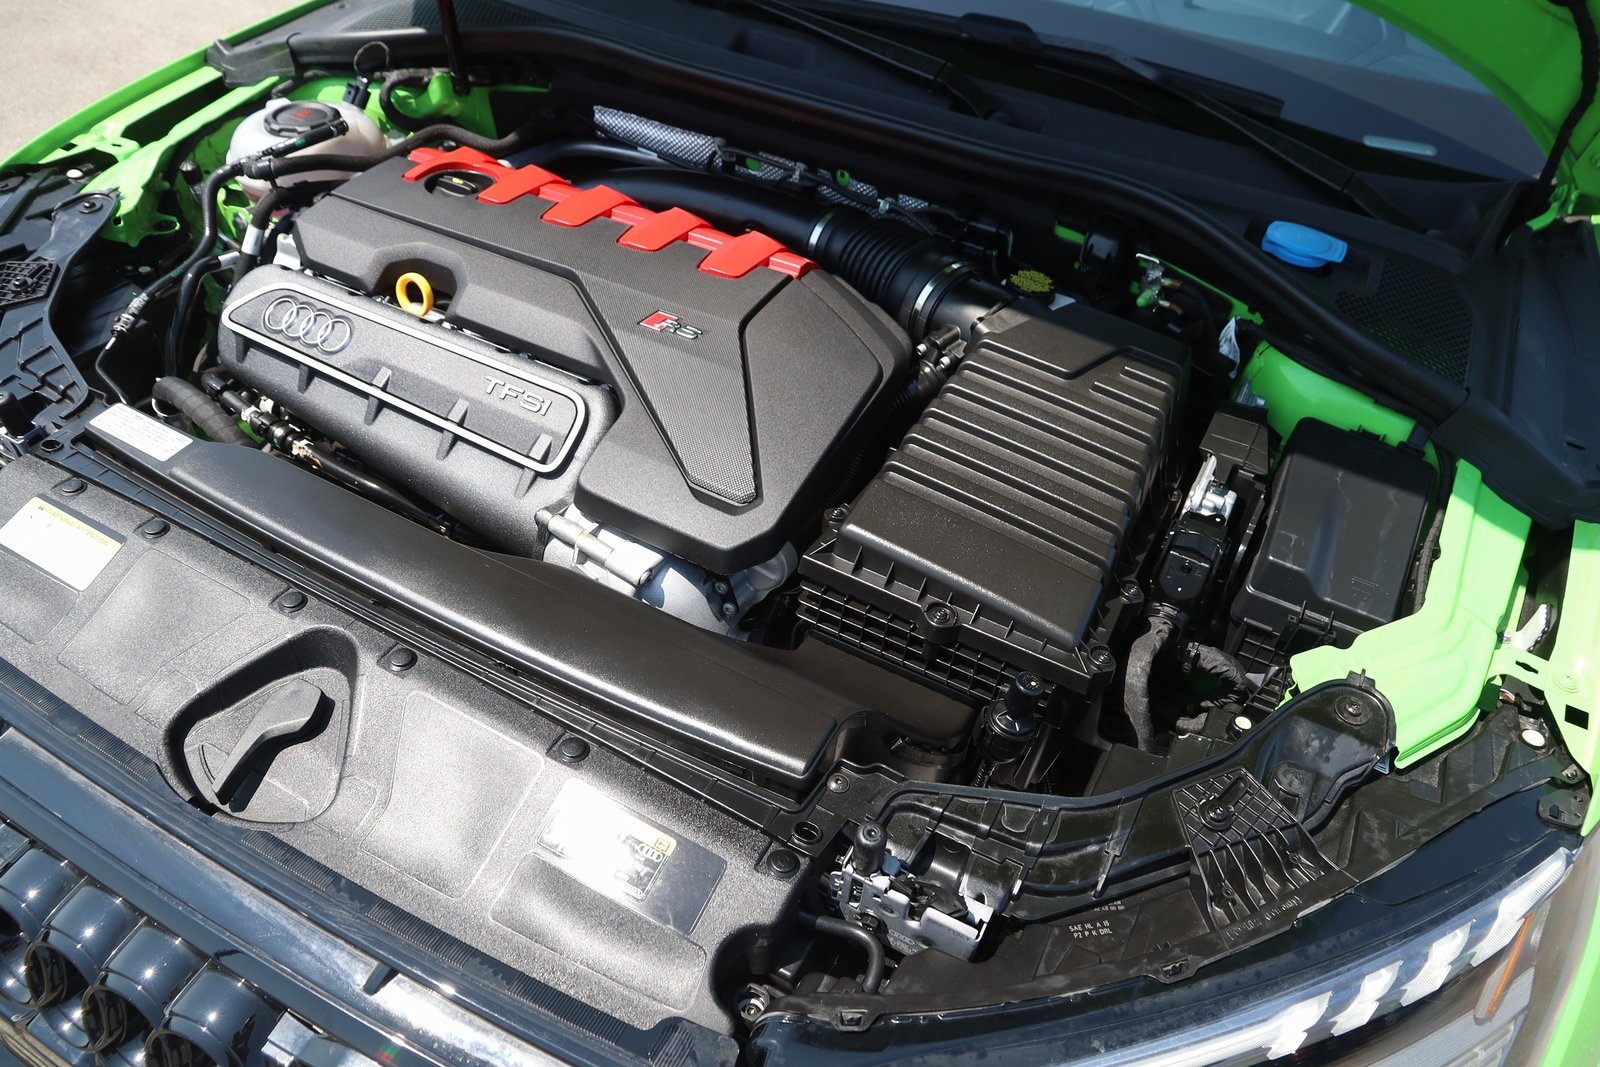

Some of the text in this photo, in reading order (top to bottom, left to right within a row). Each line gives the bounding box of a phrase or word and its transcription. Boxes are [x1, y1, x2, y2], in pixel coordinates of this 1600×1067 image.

[650, 316, 703, 339] RS
[484, 375, 552, 416] TFSI
[1068, 924, 1083, 932] SAE
[1073, 931, 1083, 939] P2
[1099, 927, 1112, 935] DRL
